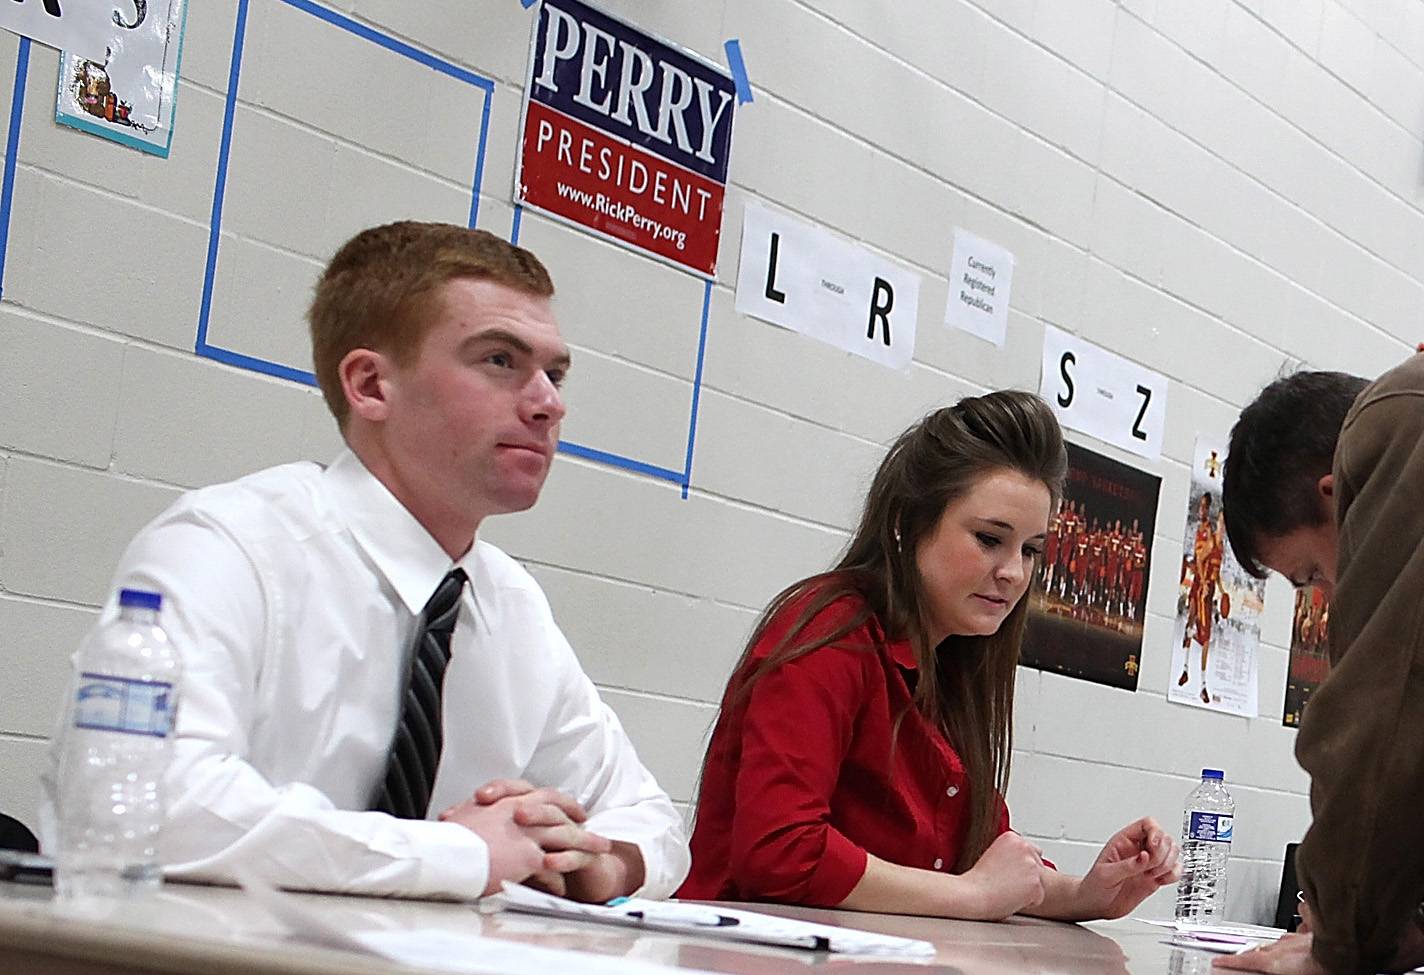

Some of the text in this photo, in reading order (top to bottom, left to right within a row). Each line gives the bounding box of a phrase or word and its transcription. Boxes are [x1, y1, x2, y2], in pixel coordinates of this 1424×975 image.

[535, 3, 732, 164] PERRY
[537, 119, 711, 221] PRESIDENT
[557, 182, 687, 250] www.RickPerry.org
[765, 233, 785, 304] L
[867, 276, 894, 346] R
[960, 290, 993, 314] Republican
[967, 256, 996, 279] Currently
[1057, 351, 1152, 441] S Z
